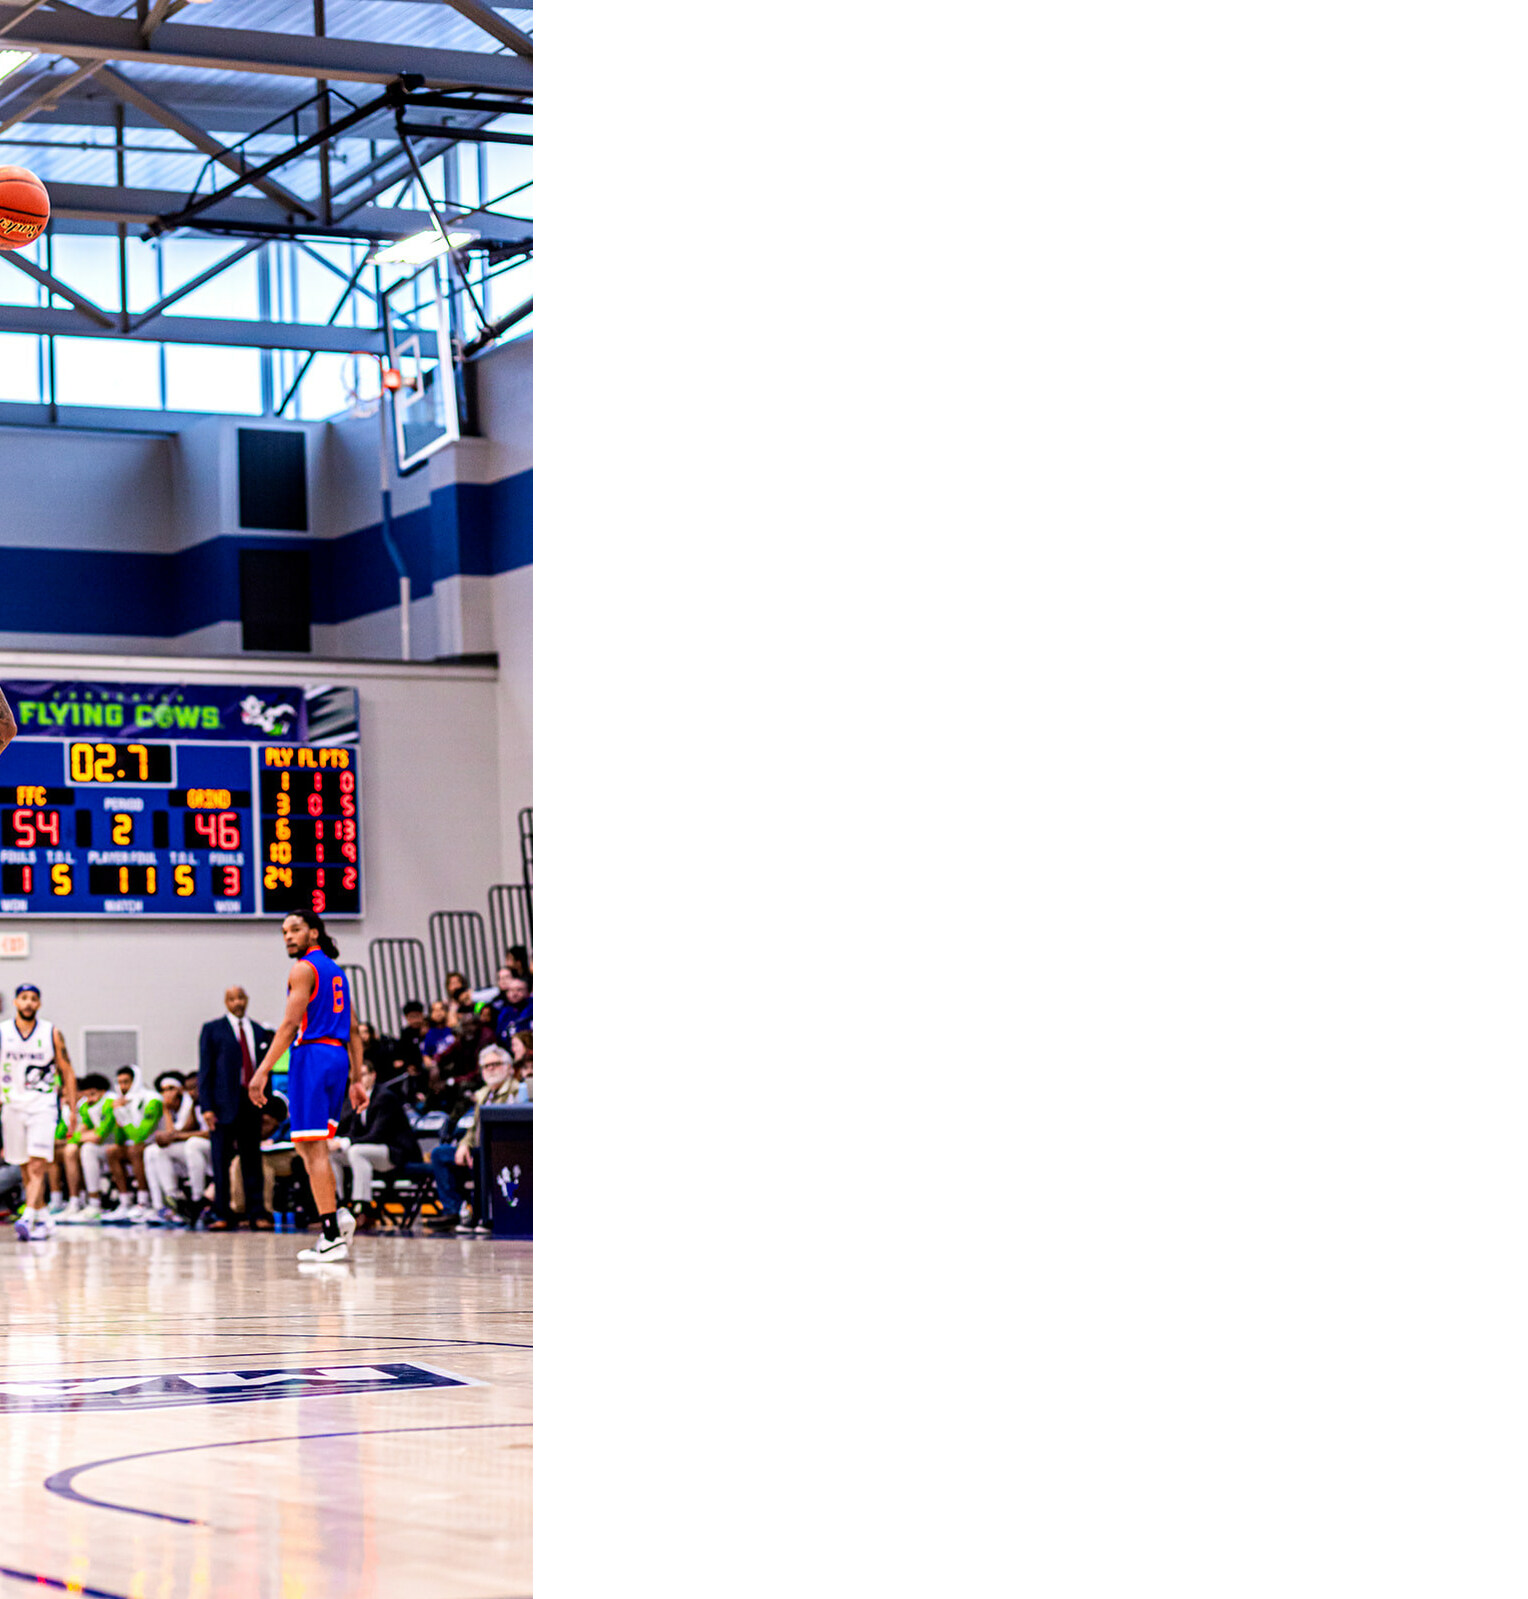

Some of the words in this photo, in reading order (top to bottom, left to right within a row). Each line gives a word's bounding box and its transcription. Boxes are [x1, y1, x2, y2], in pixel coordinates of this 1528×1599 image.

[19, 702, 123, 727] FLYING
[135, 703, 220, 729] COWS
[71, 743, 148, 782] 02.7
[319, 748, 349, 768] PTS
[281, 771, 290, 791] 1
[314, 772, 322, 792] 1
[339, 770, 355, 793] 0
[103, 797, 144, 812] PERIOD
[276, 792, 291, 816] 3
[307, 793, 323, 817] 0
[13, 808, 59, 848] 54
[112, 814, 132, 846] 2
[195, 812, 240, 850] 46
[275, 817, 291, 841] 6
[315, 820, 324, 840] 1
[334, 818, 356, 842] 13
[0, 850, 37, 864] FOULS
[87, 850, 128, 865] PLAYER
[130, 851, 158, 865] FOUL
[209, 851, 244, 866] FOULS
[270, 841, 292, 864] 10
[316, 843, 324, 863] 1
[341, 842, 357, 863] 9
[22, 865, 32, 893] 1
[51, 863, 72, 895] 5
[174, 864, 194, 896] 5
[223, 865, 240, 896] 3
[264, 865, 292, 890] 24
[316, 868, 325, 888] 1
[342, 866, 357, 890] 2
[312, 889, 326, 913] 3
[332, 975, 345, 1014] 6
